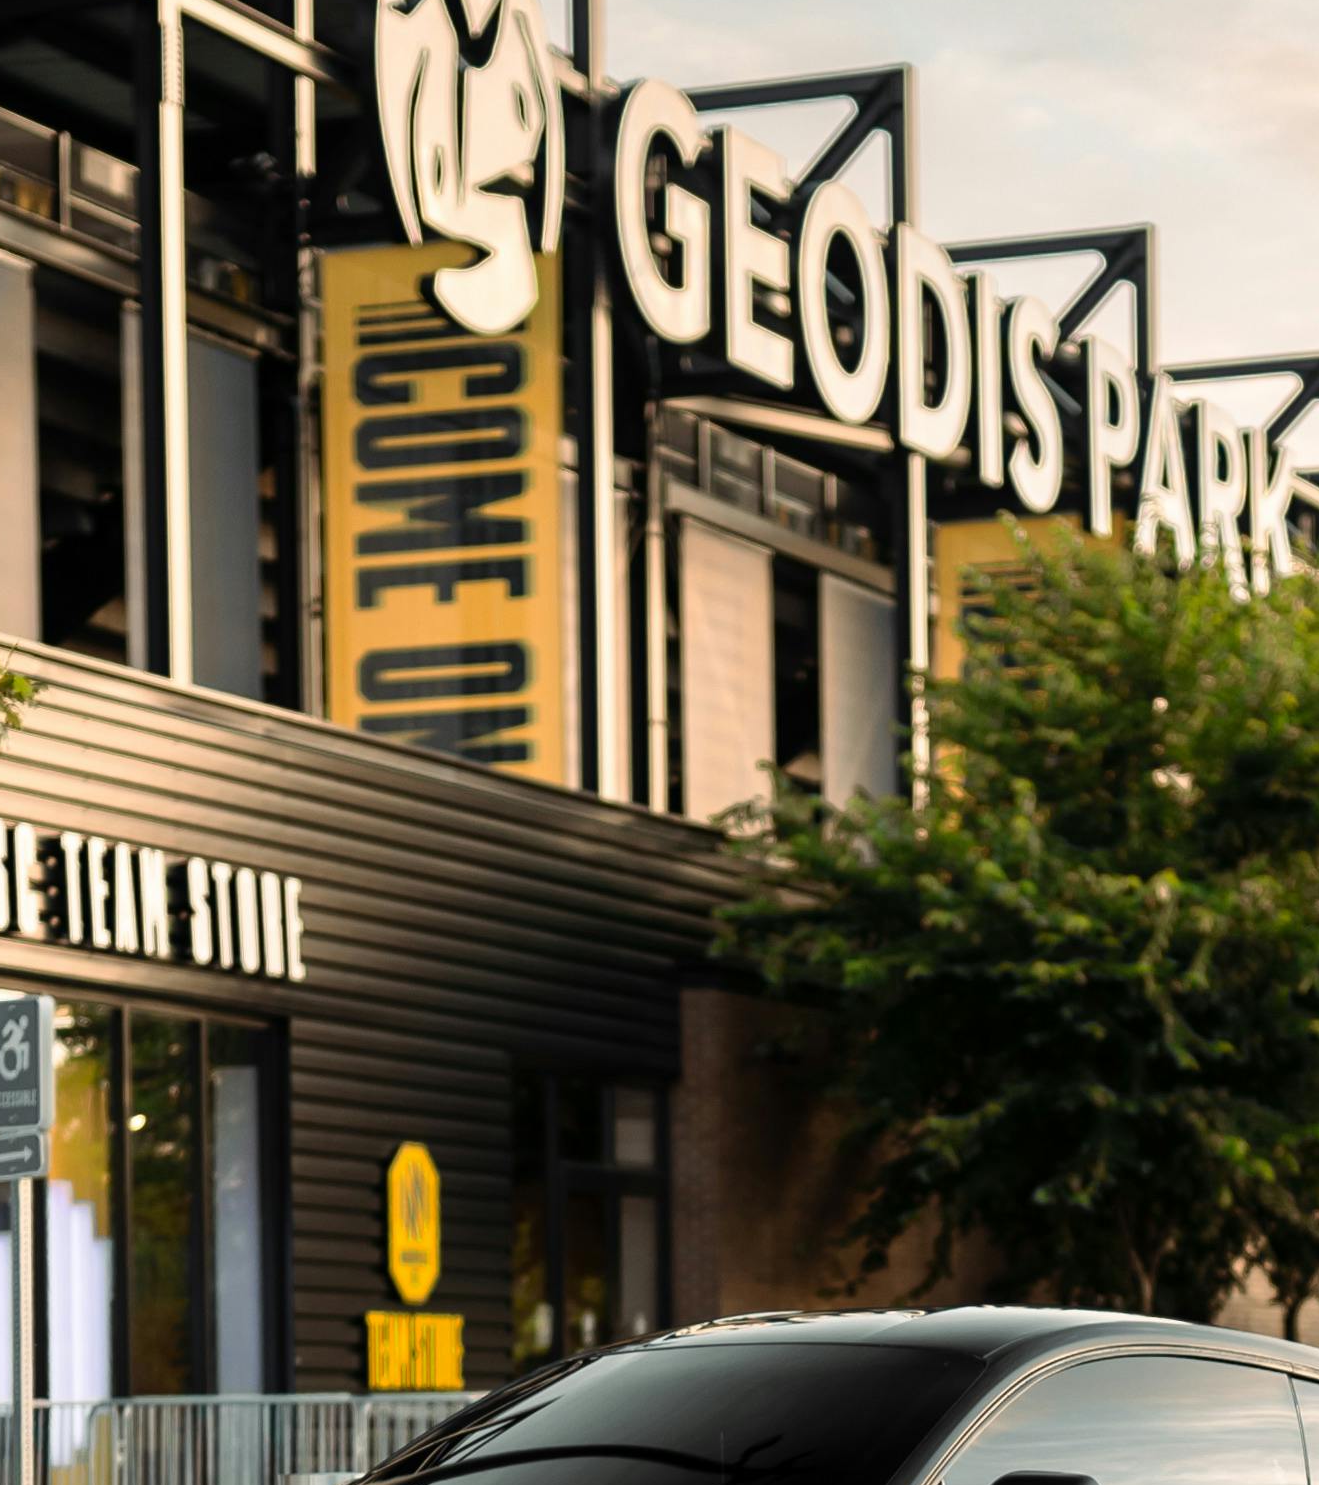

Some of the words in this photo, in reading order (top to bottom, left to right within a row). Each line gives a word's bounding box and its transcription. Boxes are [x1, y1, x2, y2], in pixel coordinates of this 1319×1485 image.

[616, 77, 1062, 512] GEODIS
[1088, 337, 1293, 603] PARK
[353, 341, 537, 611] COME
[355, 640, 537, 769] ON
[61, 831, 169, 958] TEAM
[188, 857, 306, 982] STORE
